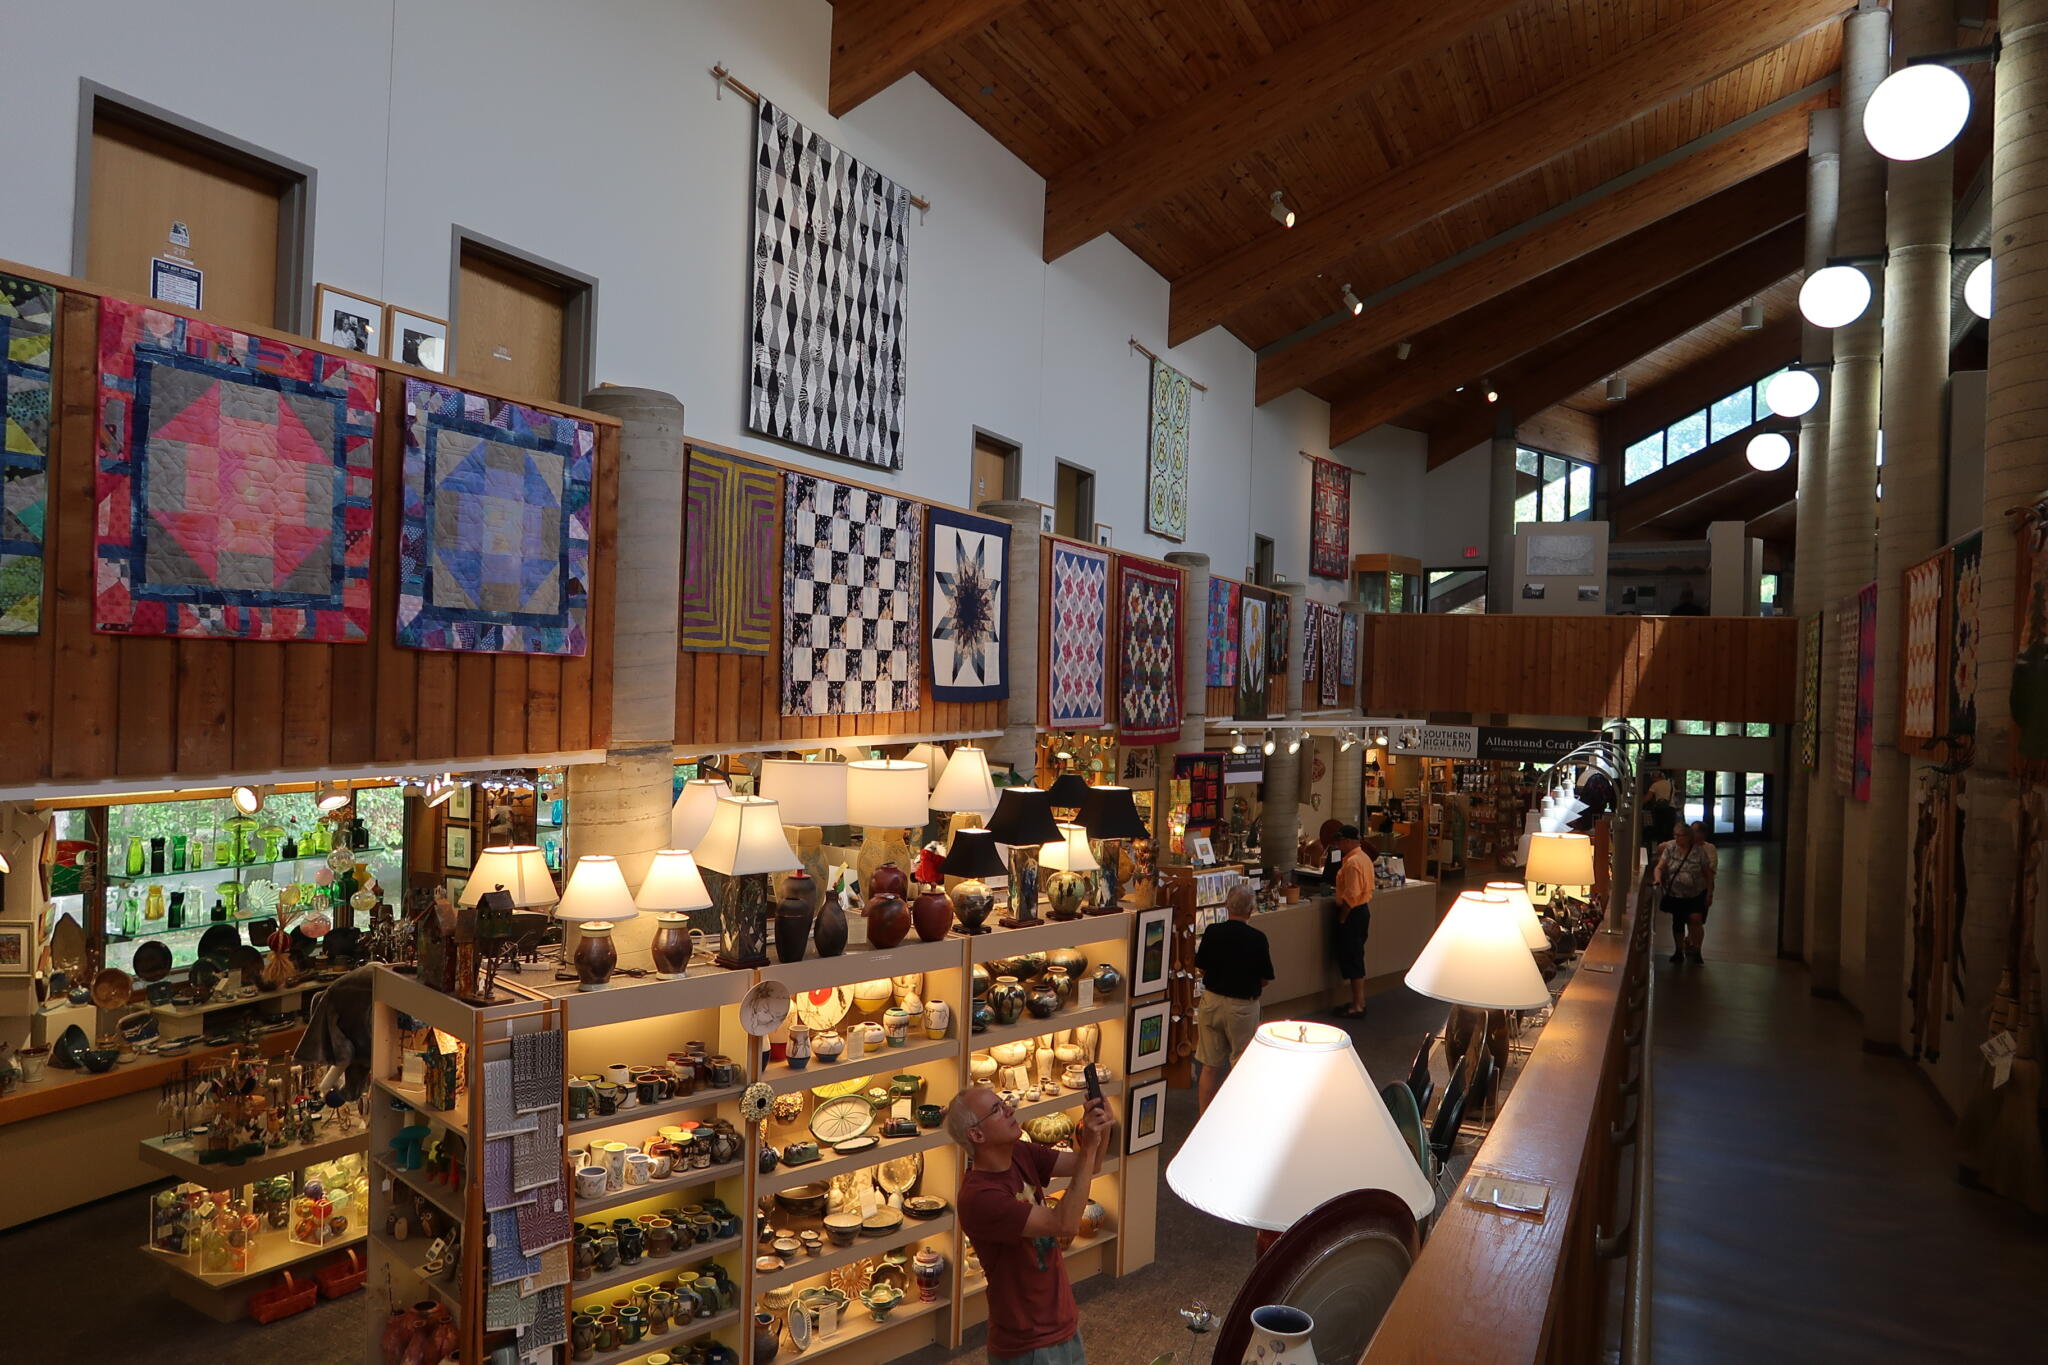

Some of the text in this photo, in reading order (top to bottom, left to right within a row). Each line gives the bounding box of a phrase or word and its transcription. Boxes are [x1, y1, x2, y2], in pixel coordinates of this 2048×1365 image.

[1424, 730, 1471, 740] SOUTHERN
[1423, 739, 1472, 752] HIGHLAND
[1485, 736, 1542, 748] Allanstand
[1545, 740, 1573, 750] Craft
